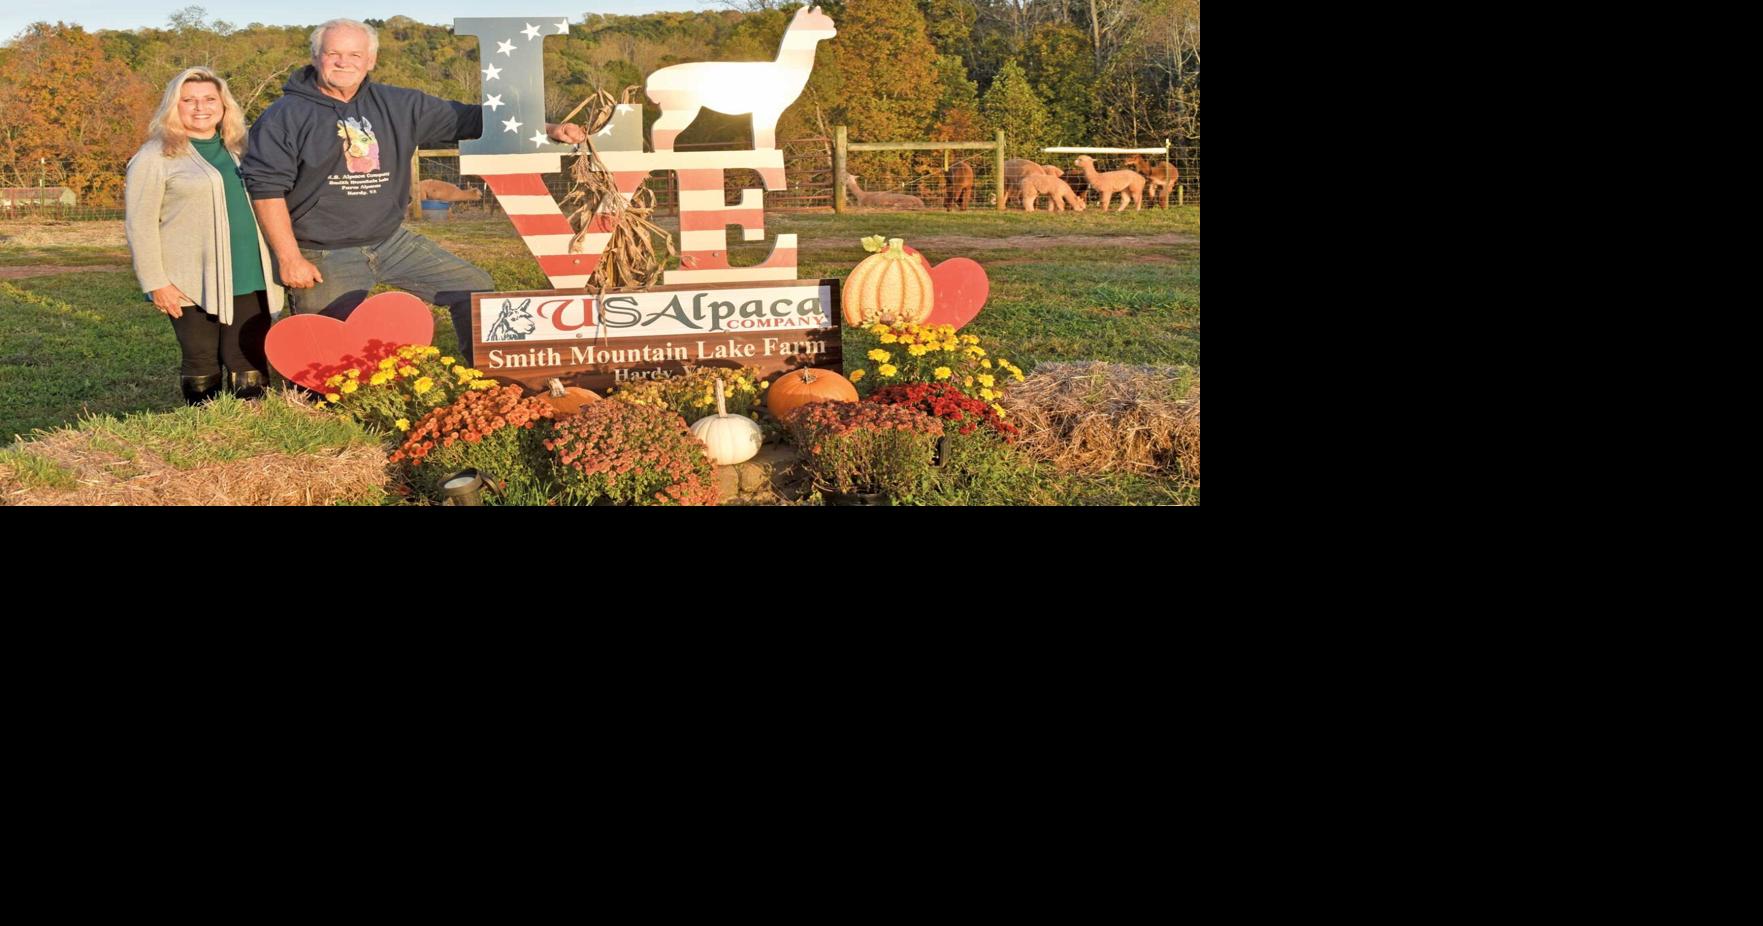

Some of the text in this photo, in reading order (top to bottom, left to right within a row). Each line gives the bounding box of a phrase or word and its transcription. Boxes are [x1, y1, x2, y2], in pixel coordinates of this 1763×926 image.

[726, 316, 825, 329] COMPANY
[488, 337, 826, 369] Smith Mountain Lake Farm
